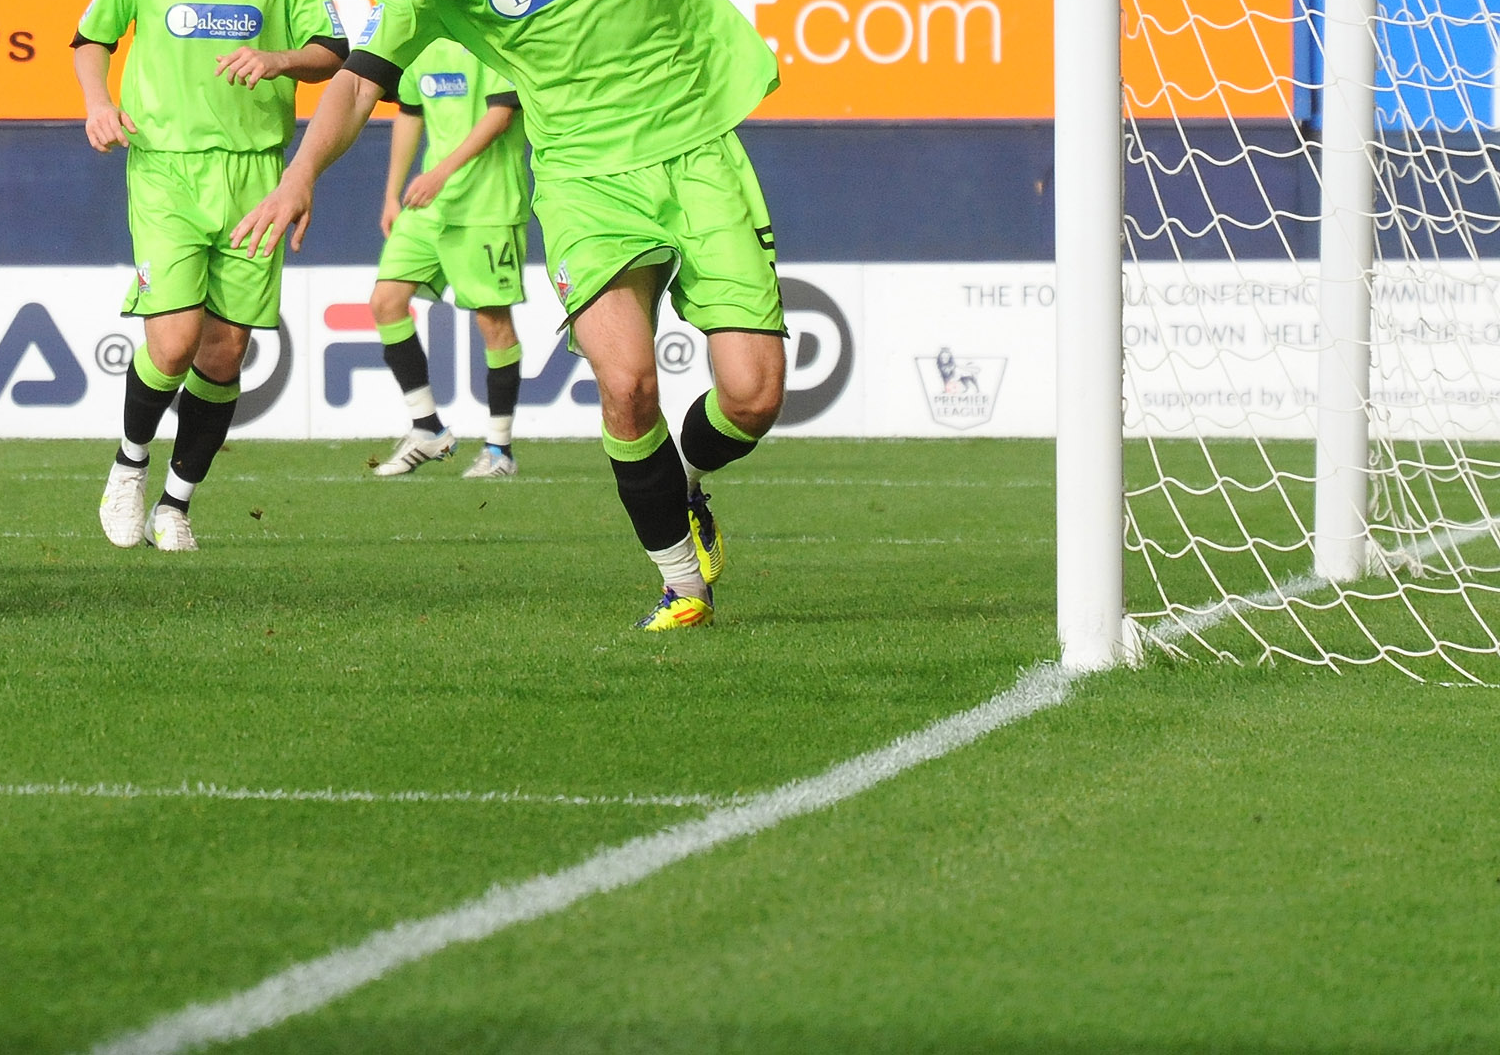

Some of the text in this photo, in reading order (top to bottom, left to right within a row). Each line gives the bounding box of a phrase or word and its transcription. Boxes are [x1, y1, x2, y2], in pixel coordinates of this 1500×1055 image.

[181, 10, 257, 32] Lakeside
[483, 241, 516, 274] 14
[961, 284, 1012, 308] THE
[1164, 282, 1319, 307] CONFERENC
